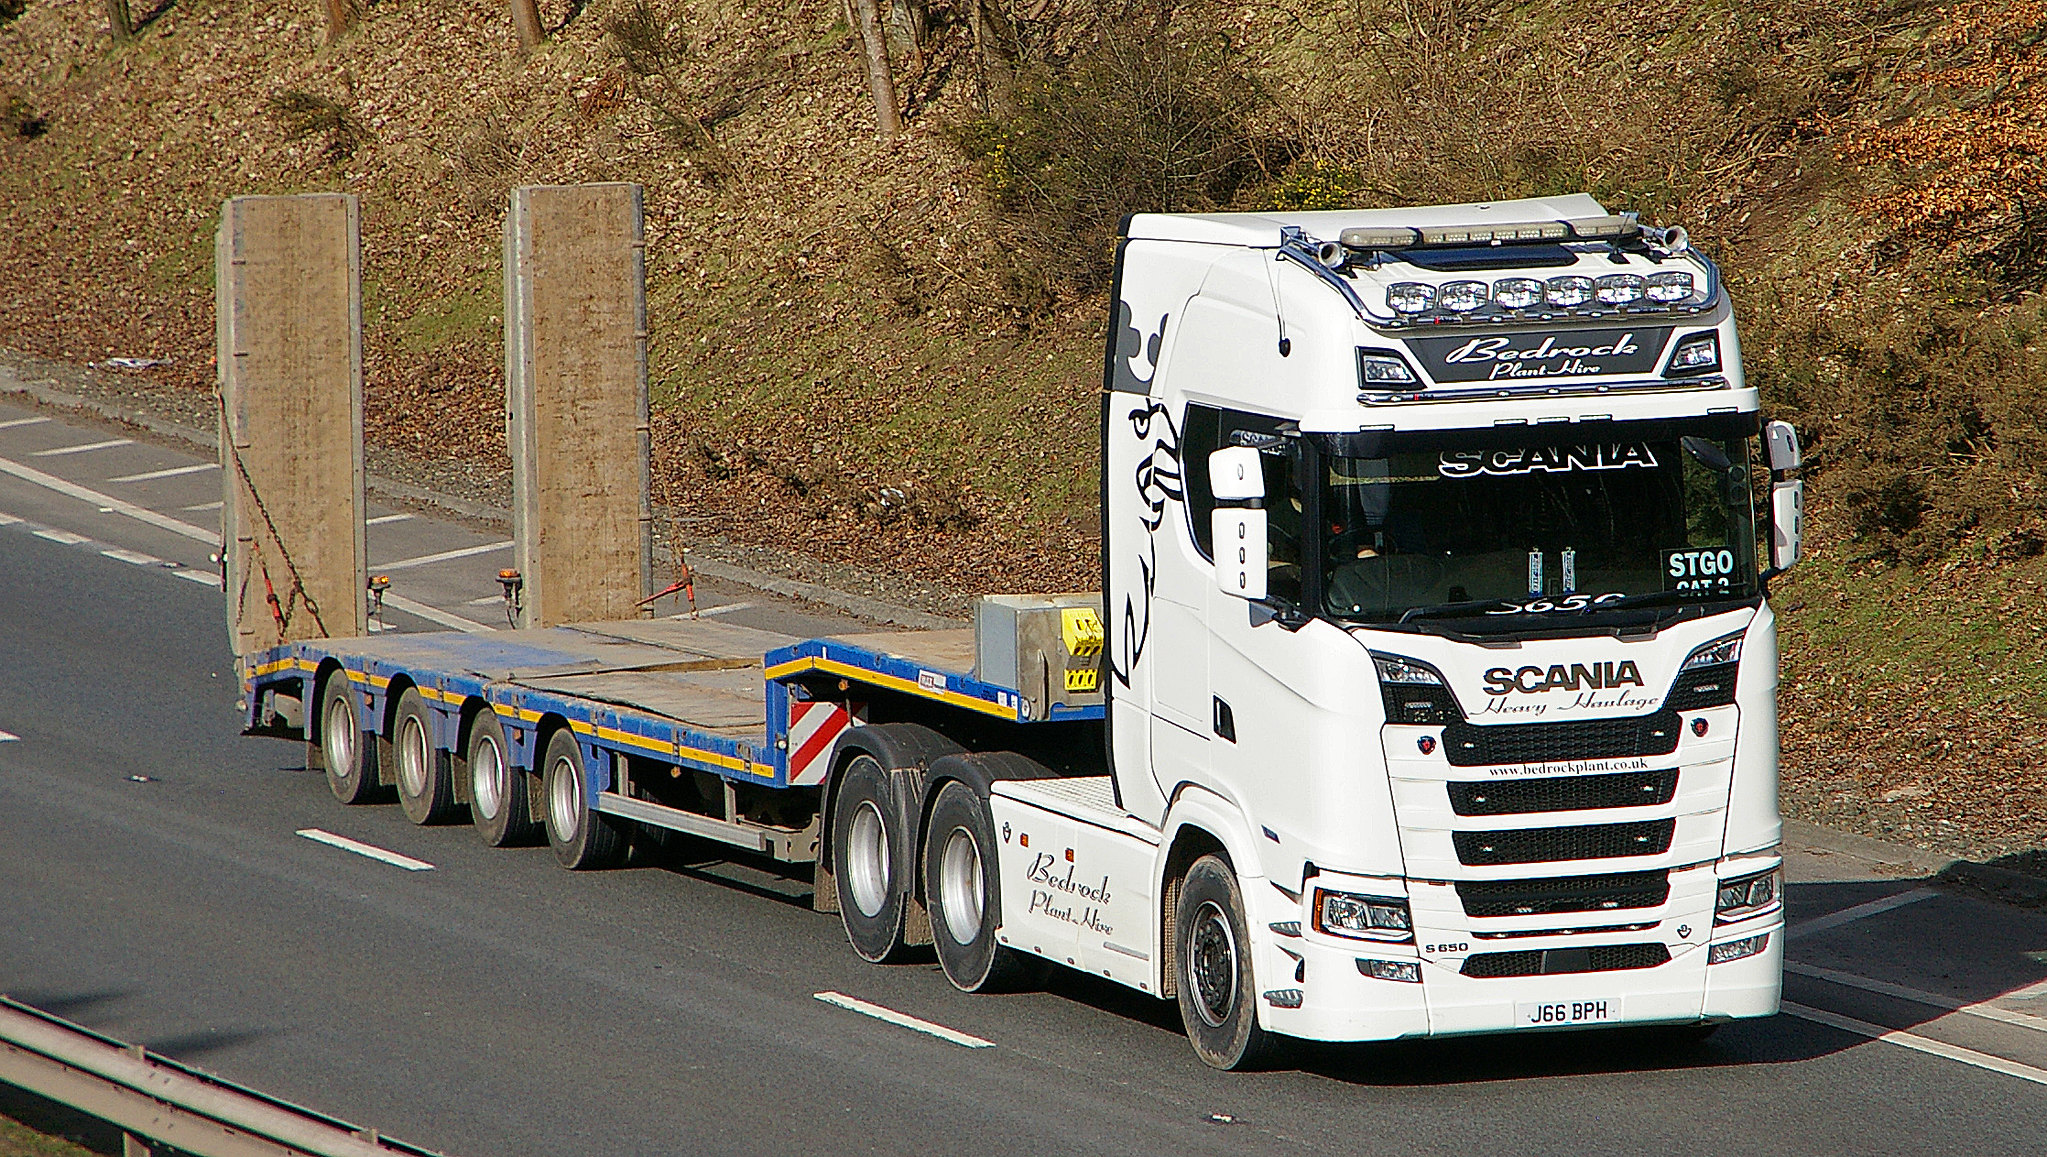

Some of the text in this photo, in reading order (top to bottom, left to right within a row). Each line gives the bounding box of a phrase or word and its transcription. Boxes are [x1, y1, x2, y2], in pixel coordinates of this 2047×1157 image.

[1445, 332, 1639, 363] Bedrock
[1488, 358, 1601, 381] Plant Hire
[1439, 441, 1659, 478] SCANIA
[1669, 550, 1734, 578] STGO
[1482, 660, 1645, 696] SCANIA
[1468, 689, 1660, 717] Heavy Haulage
[1489, 757, 1649, 777] www.bedrockplant.co.uk
[1026, 852, 1112, 906] Bedrock
[1028, 889, 1114, 936] Plant Hire
[1425, 941, 1469, 954] S 650
[1530, 1000, 1608, 1024] J66 BPH
